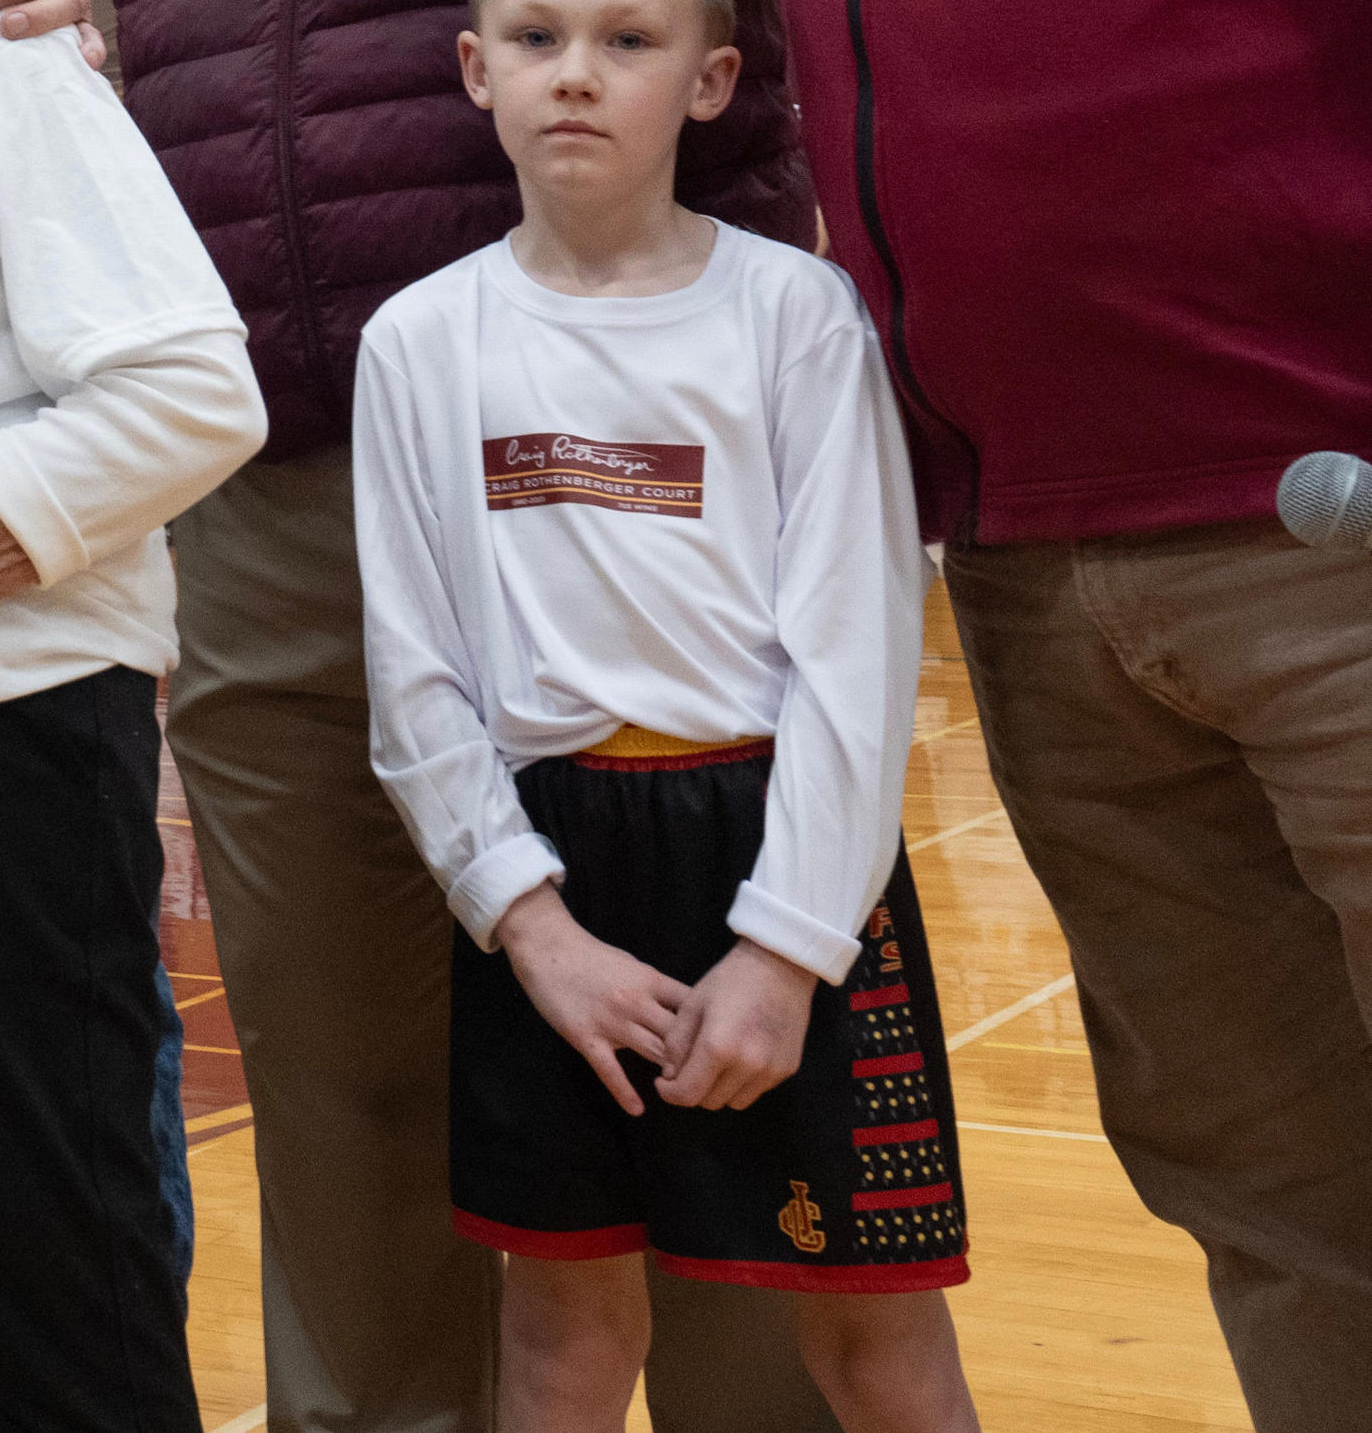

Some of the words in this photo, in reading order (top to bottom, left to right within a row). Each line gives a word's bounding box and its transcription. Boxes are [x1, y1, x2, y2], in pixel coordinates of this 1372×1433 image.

[486, 481, 520, 494] CRAIG
[524, 475, 635, 495] ROTHENBERGER
[642, 488, 696, 500] COURT
